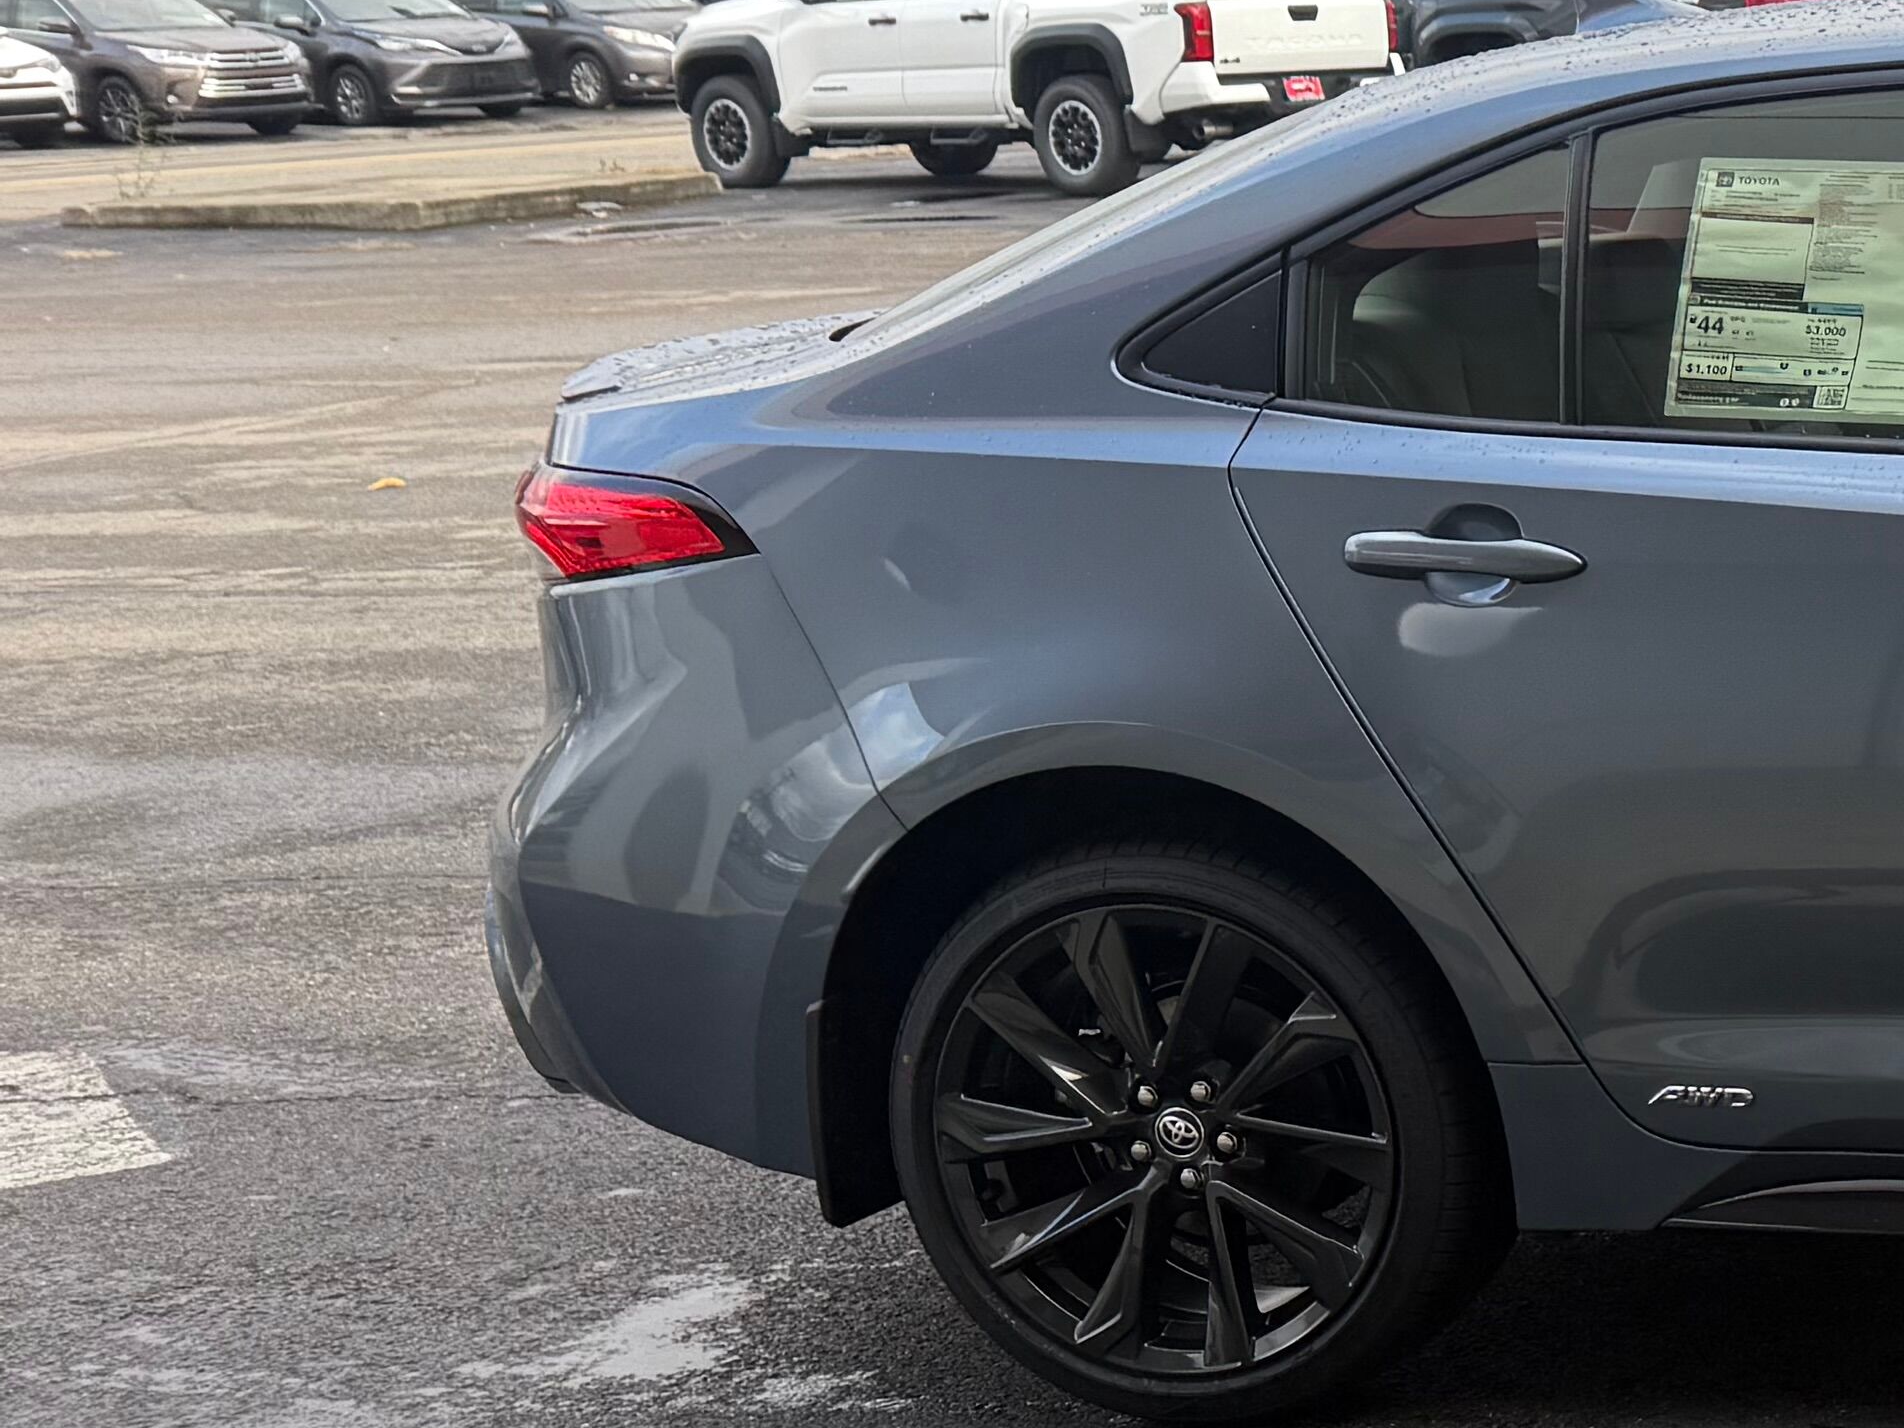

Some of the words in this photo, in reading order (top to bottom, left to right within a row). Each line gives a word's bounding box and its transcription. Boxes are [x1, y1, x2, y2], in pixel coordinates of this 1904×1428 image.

[1739, 175, 1780, 186] TOYOTA
[1697, 315, 1725, 335] 44
[1647, 1085, 1754, 1107] AWD
